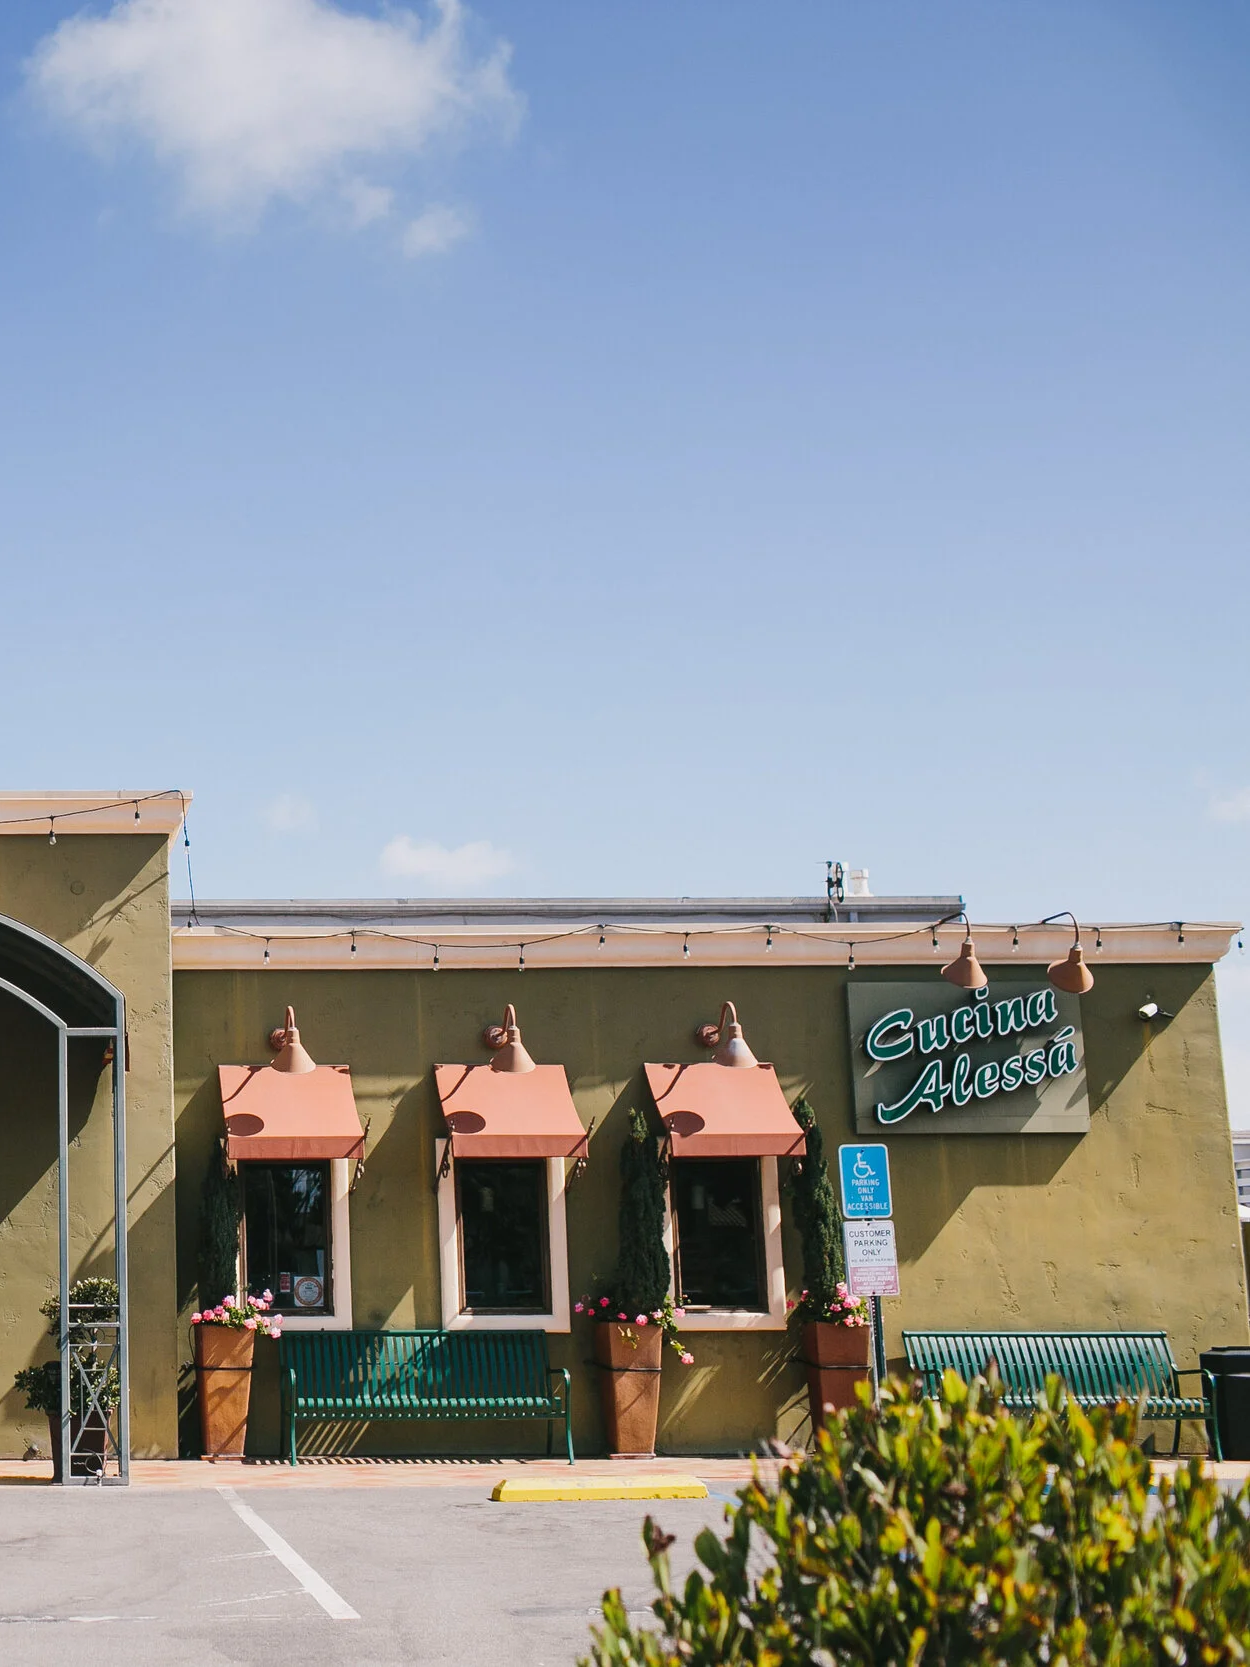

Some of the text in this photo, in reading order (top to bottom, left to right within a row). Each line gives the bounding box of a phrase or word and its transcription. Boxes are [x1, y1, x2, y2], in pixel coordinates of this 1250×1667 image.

[866, 985, 1058, 1061] Cucina
[877, 1025, 1079, 1124] Alessá
[851, 1179, 880, 1187] PARKING
[860, 1194, 874, 1202] VAN
[847, 1202, 889, 1210] ACCESSIBLE
[848, 1229, 891, 1238] CUSTOMER
[853, 1239, 888, 1247] PARKING
[861, 1248, 881, 1256] ONLY
